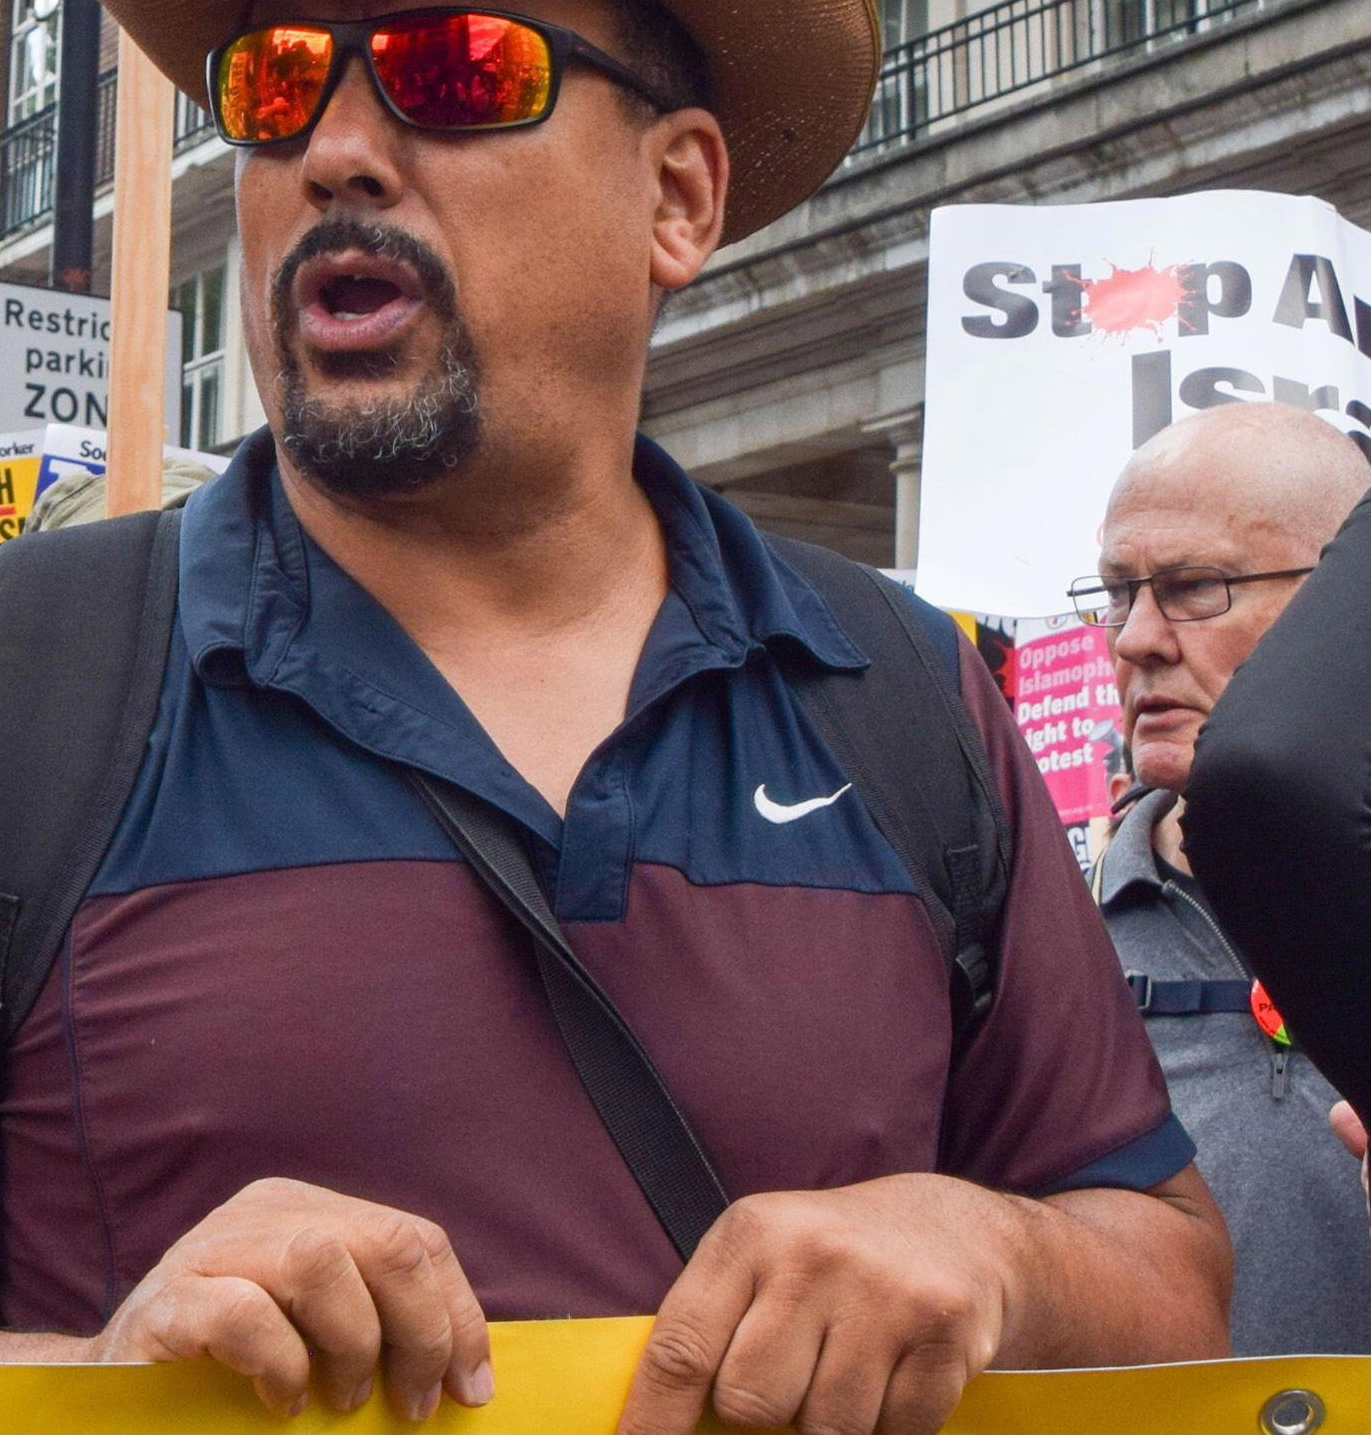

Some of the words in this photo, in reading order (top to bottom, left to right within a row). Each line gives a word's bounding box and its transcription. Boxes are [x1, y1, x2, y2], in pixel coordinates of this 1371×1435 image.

[961, 260, 1252, 339] Stp
[26, 347, 109, 379] parki
[1019, 634, 1095, 671] Oppose
[1017, 685, 1090, 726] Defend
[1072, 716, 1095, 738] to
